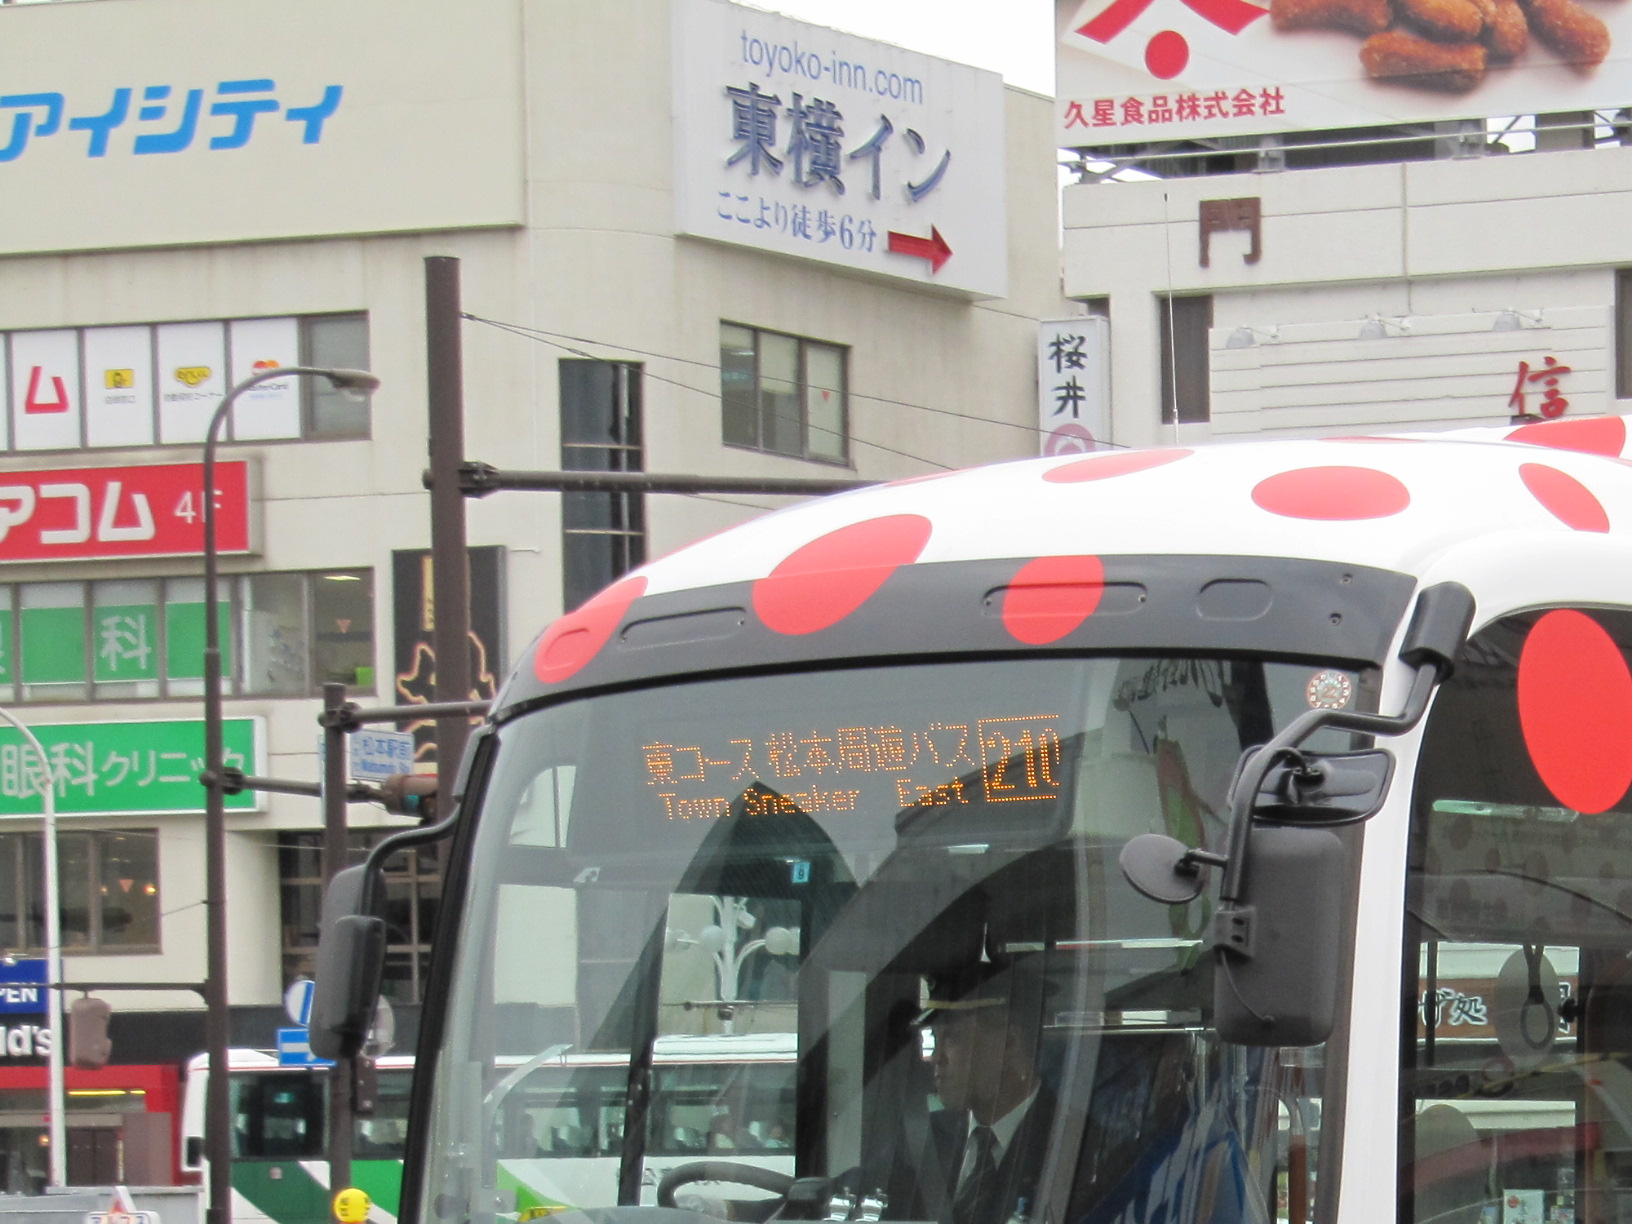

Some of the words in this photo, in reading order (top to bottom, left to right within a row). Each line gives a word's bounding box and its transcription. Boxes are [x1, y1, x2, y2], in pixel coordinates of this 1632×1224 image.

[741, 30, 924, 105] toyoko-inn.com
[0, 79, 344, 163] アイシティ
[1064, 86, 1286, 131] 久星食品株式会社
[726, 82, 951, 204] 東横イン
[717, 191, 879, 253] ここより徒歩6分
[1048, 332, 1089, 419] 桜井
[1509, 356, 1572, 421] 信
[100, 613, 152, 672] 科
[658, 792, 732, 820] Town
[742, 784, 861, 817] Sneaker
[896, 776, 970, 809] East
